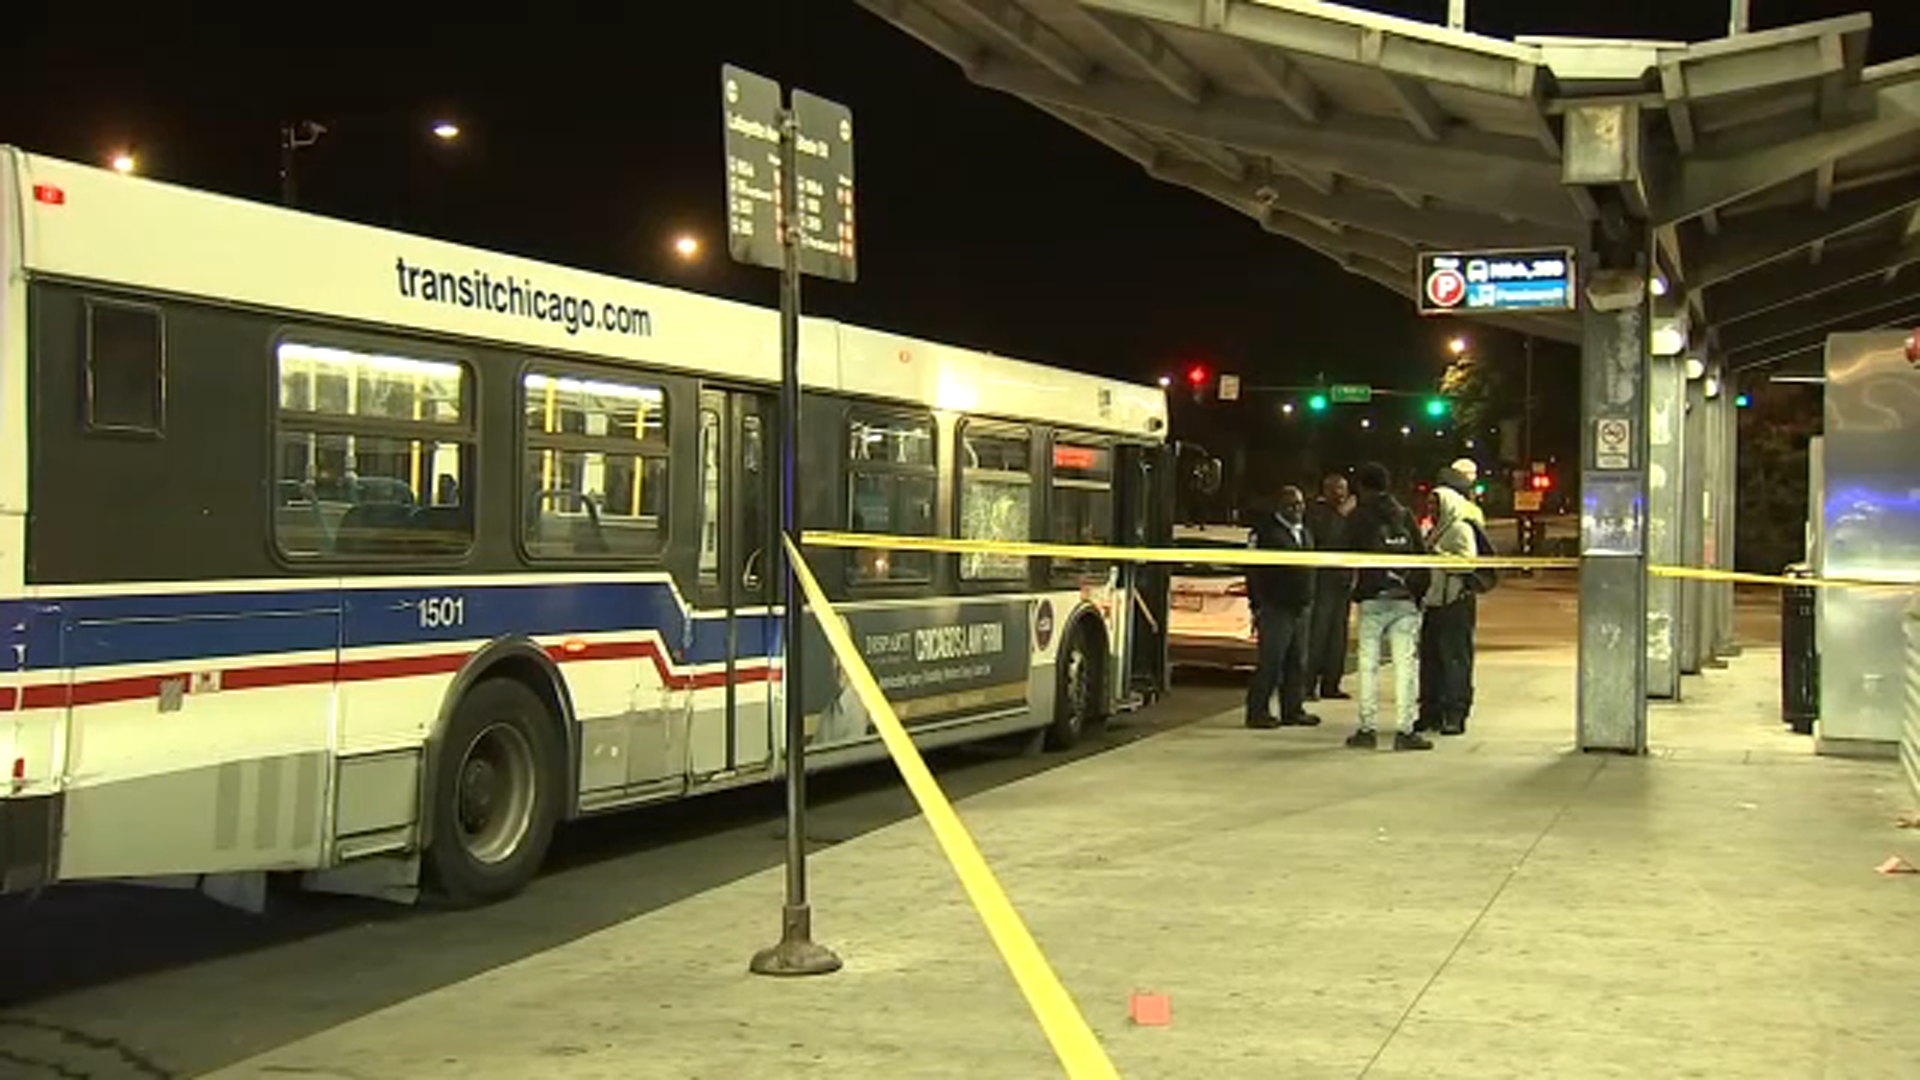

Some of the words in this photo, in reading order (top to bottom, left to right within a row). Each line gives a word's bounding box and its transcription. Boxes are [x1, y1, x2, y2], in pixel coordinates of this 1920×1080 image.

[396, 257, 652, 336] transitchicago.com
[1438, 274, 1457, 299] P
[418, 597, 463, 627] 1501
